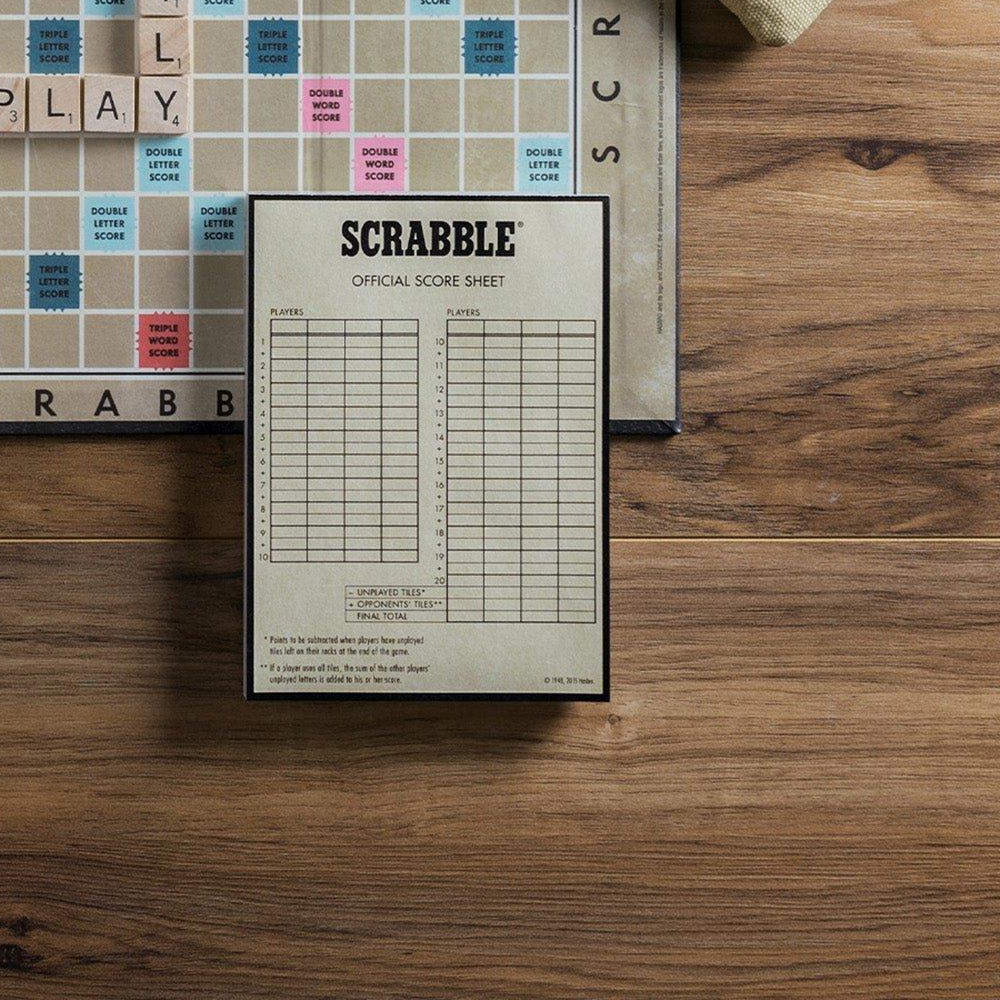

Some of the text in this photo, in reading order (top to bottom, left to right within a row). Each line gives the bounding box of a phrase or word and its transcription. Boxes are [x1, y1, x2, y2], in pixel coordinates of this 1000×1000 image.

[474, 30, 504, 39] TRIPLE
[474, 42, 505, 51] LETTER
[474, 54, 504, 64] SCORE
[309, 89, 344, 98] DOUBLE
[312, 101, 341, 110] WORD
[312, 113, 341, 122] SCORE
[526, 148, 563, 157] DOUBLE
[528, 160, 560, 169] LETTER
[529, 173, 560, 182] SCORE
[39, 265, 69, 274] TRIPLE
[38, 277, 70, 286] LETTER
[351, 274, 506, 288] OFFICIAL SCORE SHEET
[39, 289, 70, 298] SCORE
[270, 307, 304, 317] PLAYERS
[446, 308, 481, 317] PLAYERS
[149, 324, 179, 333] TRIPLE
[148, 336, 179, 345] WORD
[435, 337, 445, 346] 10
[148, 348, 180, 357] SCORE
[435, 361, 444, 370] 11
[435, 385, 445, 394] 12
[435, 409, 445, 418] 13
[435, 433, 445, 441] 14
[435, 456, 445, 466] 15
[435, 481, 445, 490] 16
[435, 504, 445, 513] 17
[435, 528, 445, 537] 18
[259, 552, 269, 562] 10
[435, 552, 445, 561] 19
[434, 576, 446, 585] 20
[356, 587, 399, 597] UNPLAYED
[356, 612, 408, 621] FINAL TOTAL
